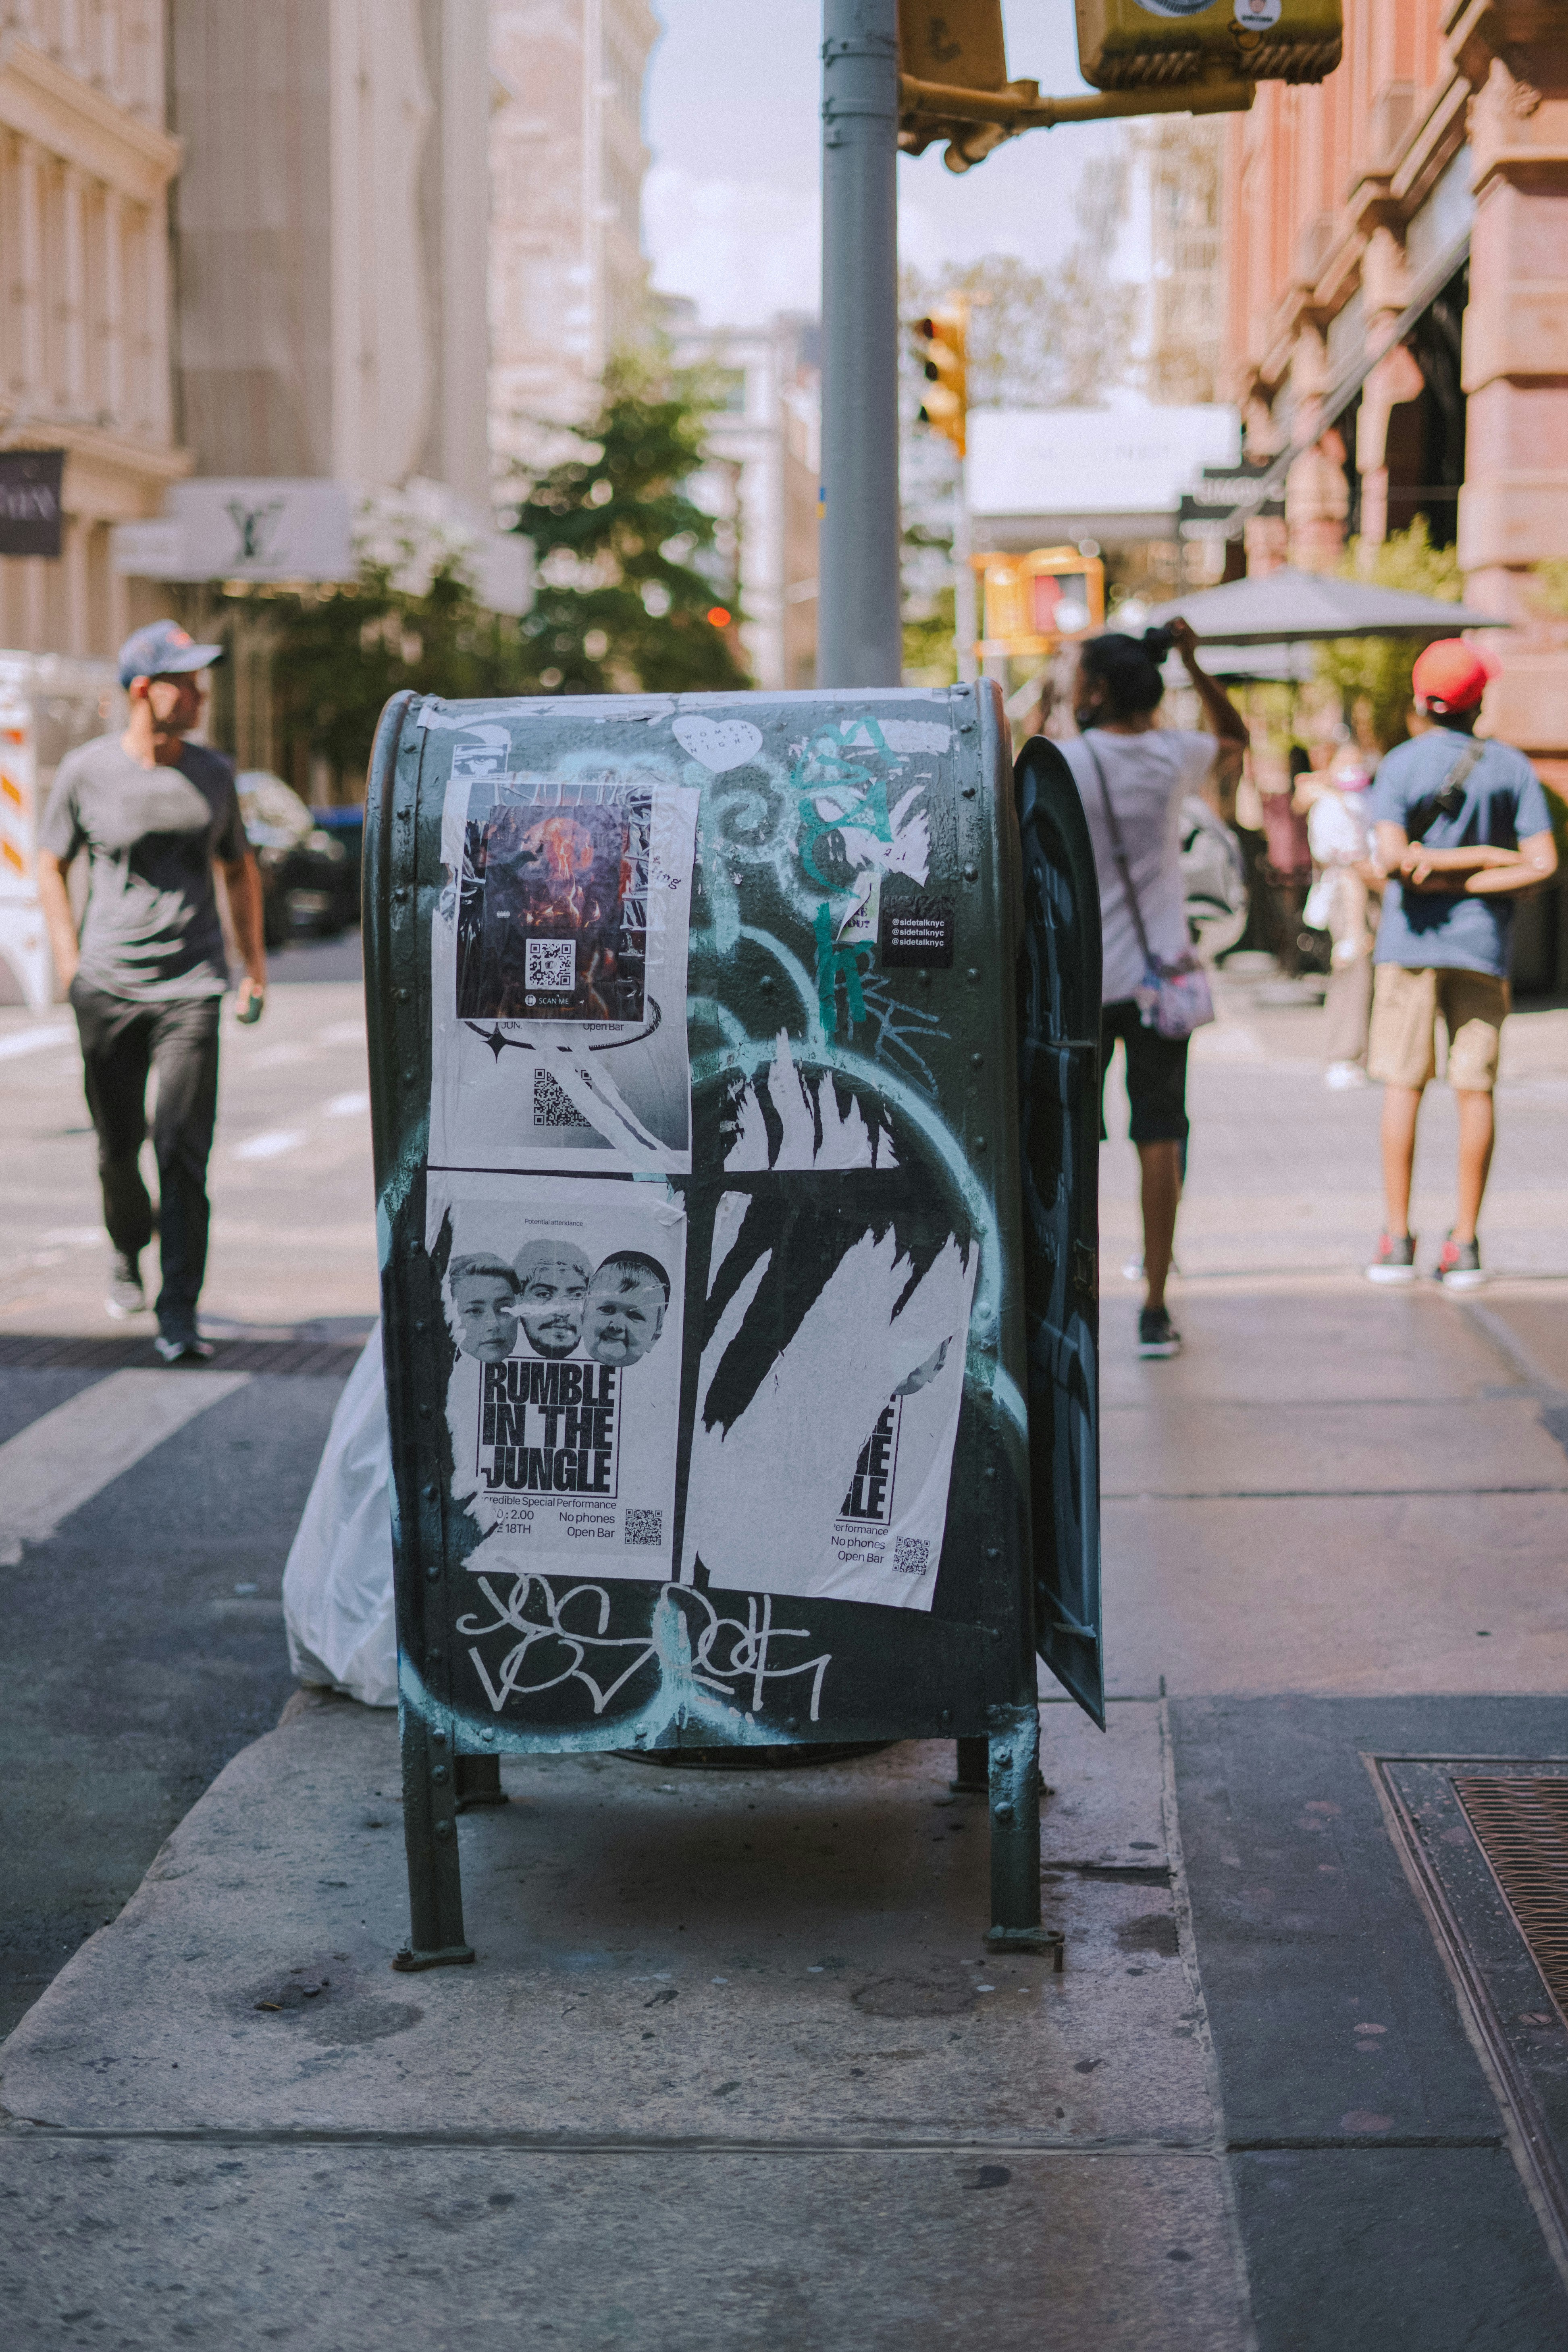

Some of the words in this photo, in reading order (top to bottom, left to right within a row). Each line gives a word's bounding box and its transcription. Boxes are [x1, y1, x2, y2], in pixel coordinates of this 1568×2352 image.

[684, 725, 748, 740] WOMEN
[690, 736, 753, 754] NIGHT
[892, 918, 944, 928] @sidetalknyc
[892, 928, 944, 938] @sidetalknyc
[892, 938, 944, 947] @sidetalknyc
[583, 1023, 607, 1031] Open
[609, 1023, 624, 1031] Bar
[484, 1361, 616, 1408] RUMBLE
[482, 1403, 526, 1447] IN
[538, 1405, 614, 1450] THE
[481, 1446, 611, 1493] JUNGLE
[522, 1497, 555, 1507] Special
[557, 1498, 616, 1509] Performance
[511, 1510, 534, 1520] 2.00
[559, 1512, 574, 1522] No
[576, 1512, 615, 1524] phones
[505, 1524, 531, 1534] 18TH
[568, 1527, 595, 1538] Open
[597, 1528, 616, 1538] Bar
[834, 1524, 888, 1535] erformance
[831, 1536, 846, 1546] No
[847, 1537, 885, 1549] phones
[838, 1551, 865, 1562] Open
[867, 1553, 885, 1563] Bar
